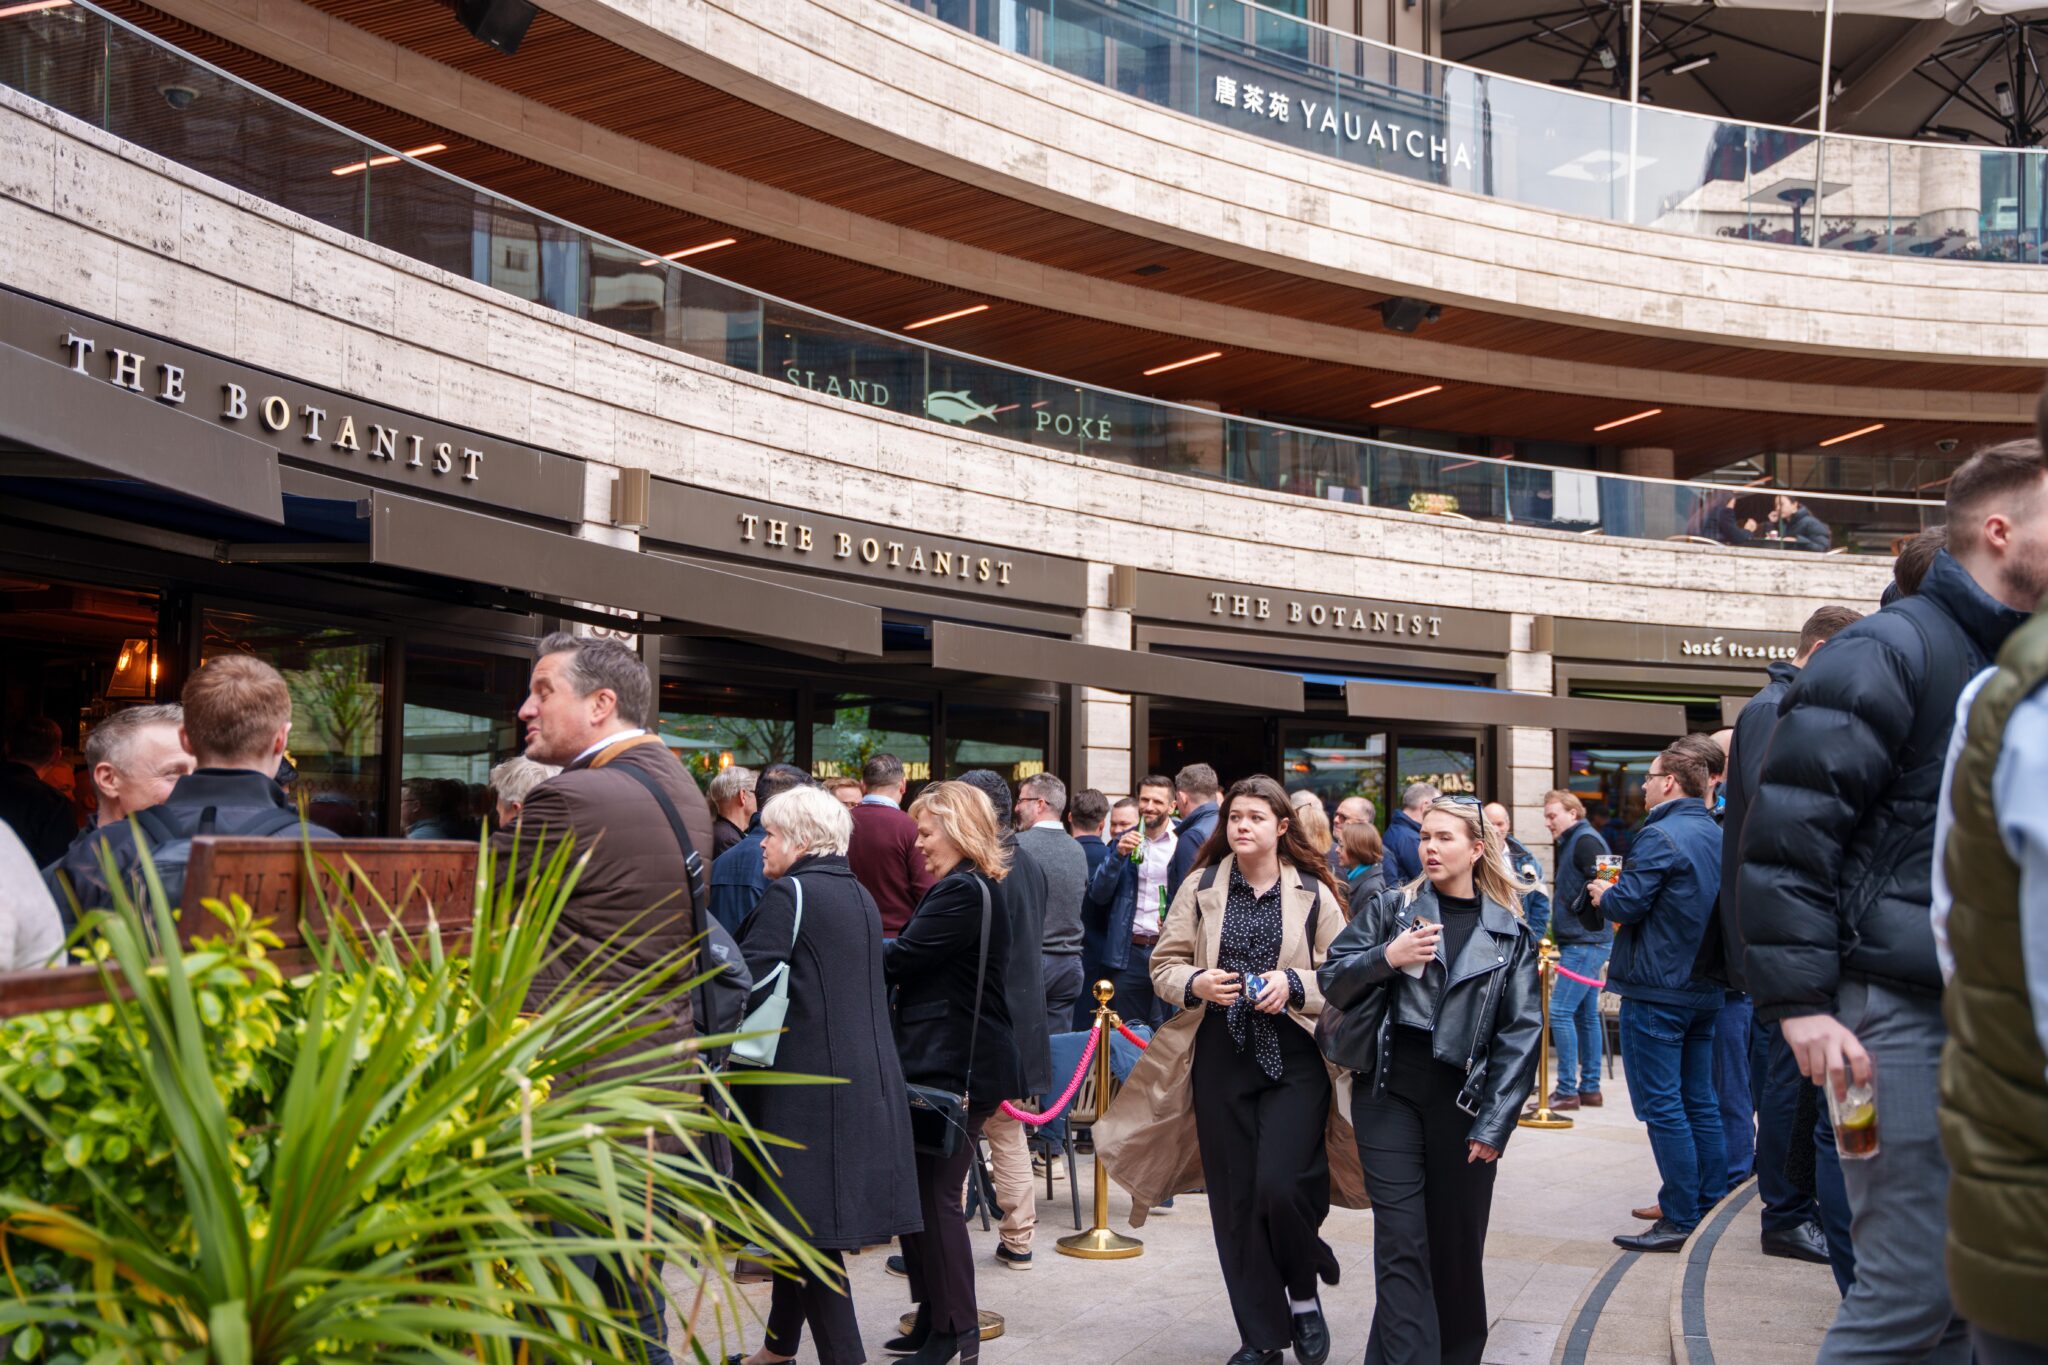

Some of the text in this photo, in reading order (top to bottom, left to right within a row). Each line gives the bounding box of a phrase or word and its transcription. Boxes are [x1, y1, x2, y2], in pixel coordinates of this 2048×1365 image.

[1215, 75, 1472, 170] 唐茶苑 YAUATCHA
[64, 333, 483, 481] THE BOTANIST
[1036, 411, 1111, 442] POKÉ
[741, 512, 1012, 584] THE BOTANIST
[1210, 591, 1442, 636] THE BOTANIST
[1682, 636, 1724, 656] JOSÉ
